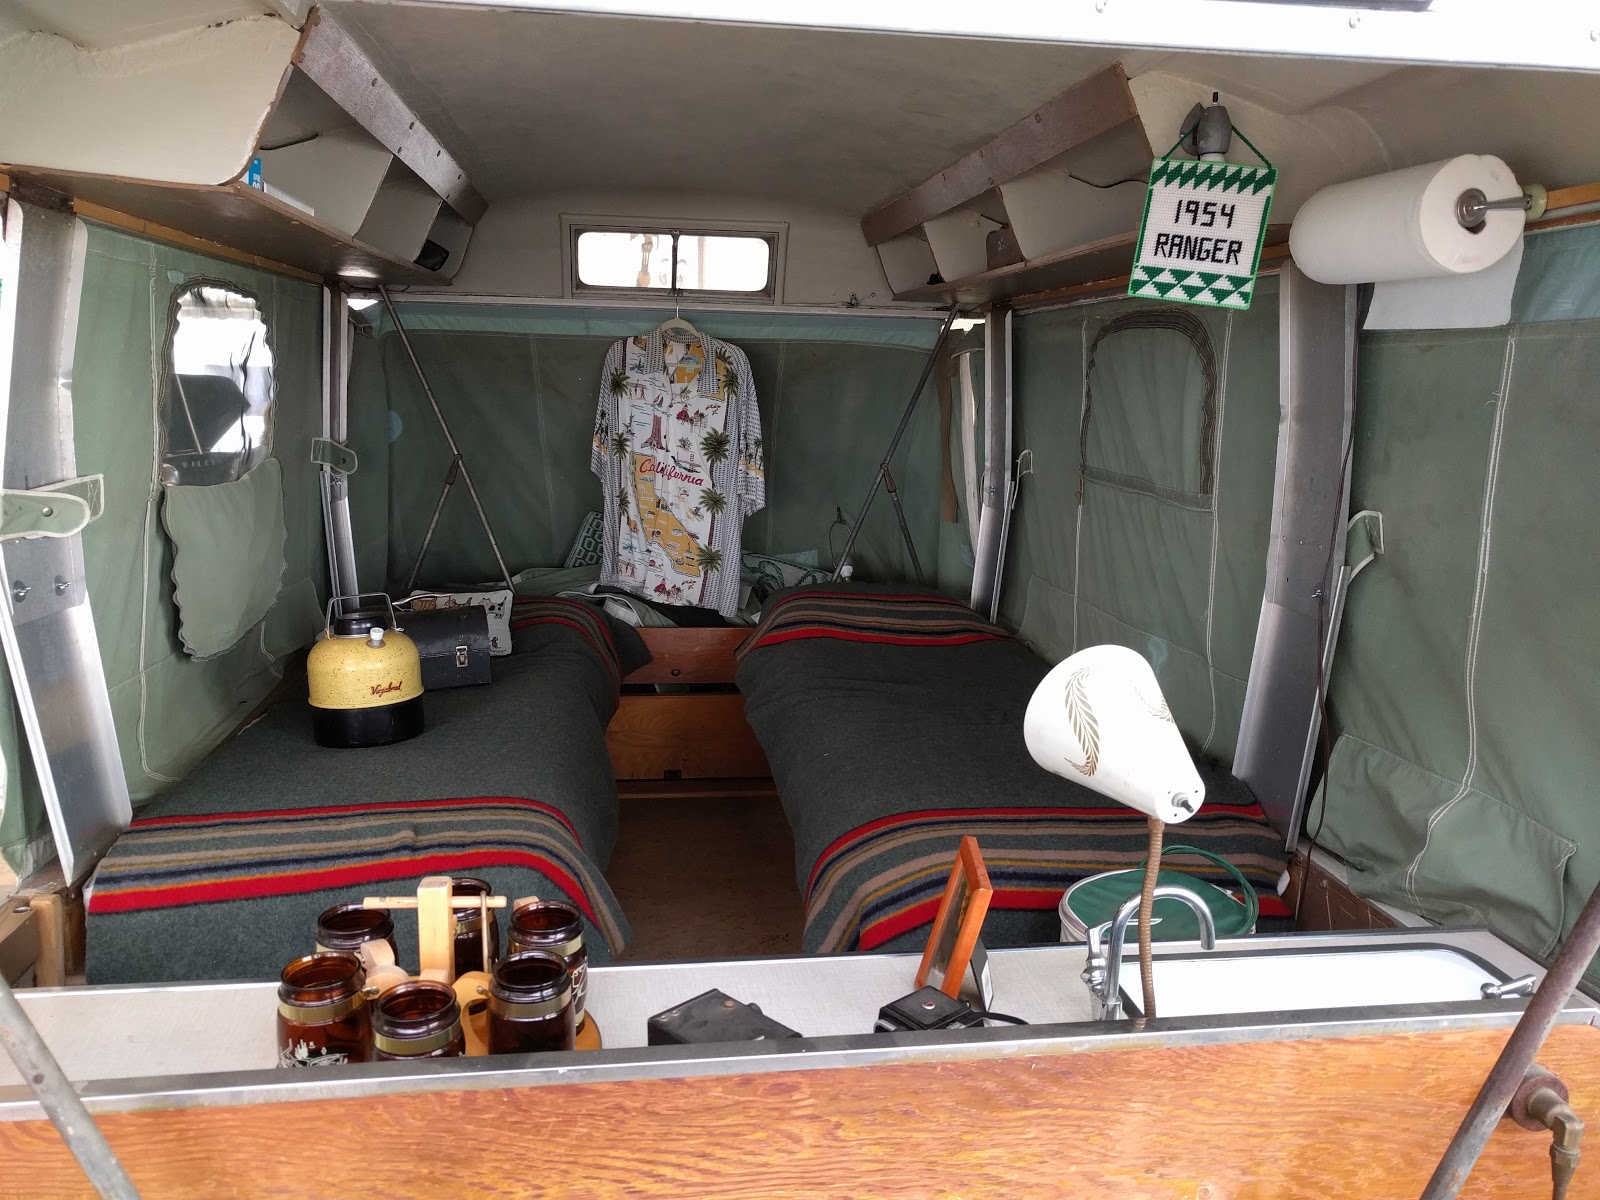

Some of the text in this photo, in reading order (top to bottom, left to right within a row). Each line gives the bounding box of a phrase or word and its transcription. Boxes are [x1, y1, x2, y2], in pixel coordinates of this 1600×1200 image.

[1174, 199, 1235, 229] 1954
[1153, 232, 1243, 265] RANGER
[639, 458, 704, 487] California
